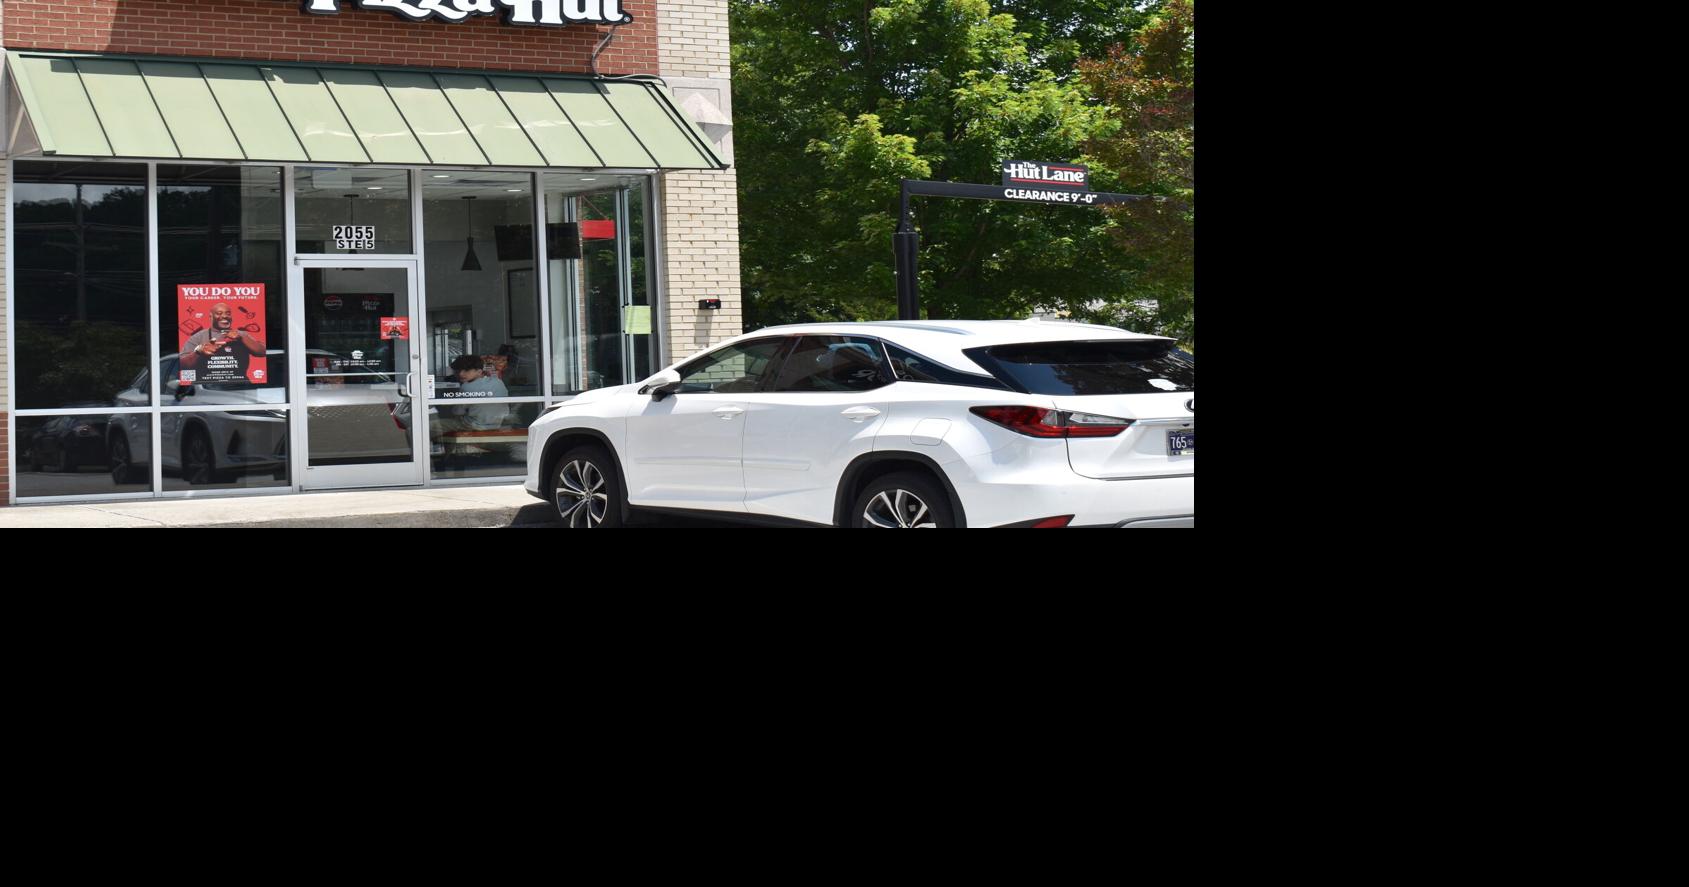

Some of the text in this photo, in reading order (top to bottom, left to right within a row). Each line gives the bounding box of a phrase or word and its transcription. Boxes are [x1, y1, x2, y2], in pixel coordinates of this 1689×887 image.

[1003, 163, 1085, 182] Hut Lane
[1004, 188, 1070, 202] CLEARANCE
[334, 226, 373, 239] 2055
[182, 286, 260, 296] YOU DO YOU
[1170, 436, 1187, 449] 765
